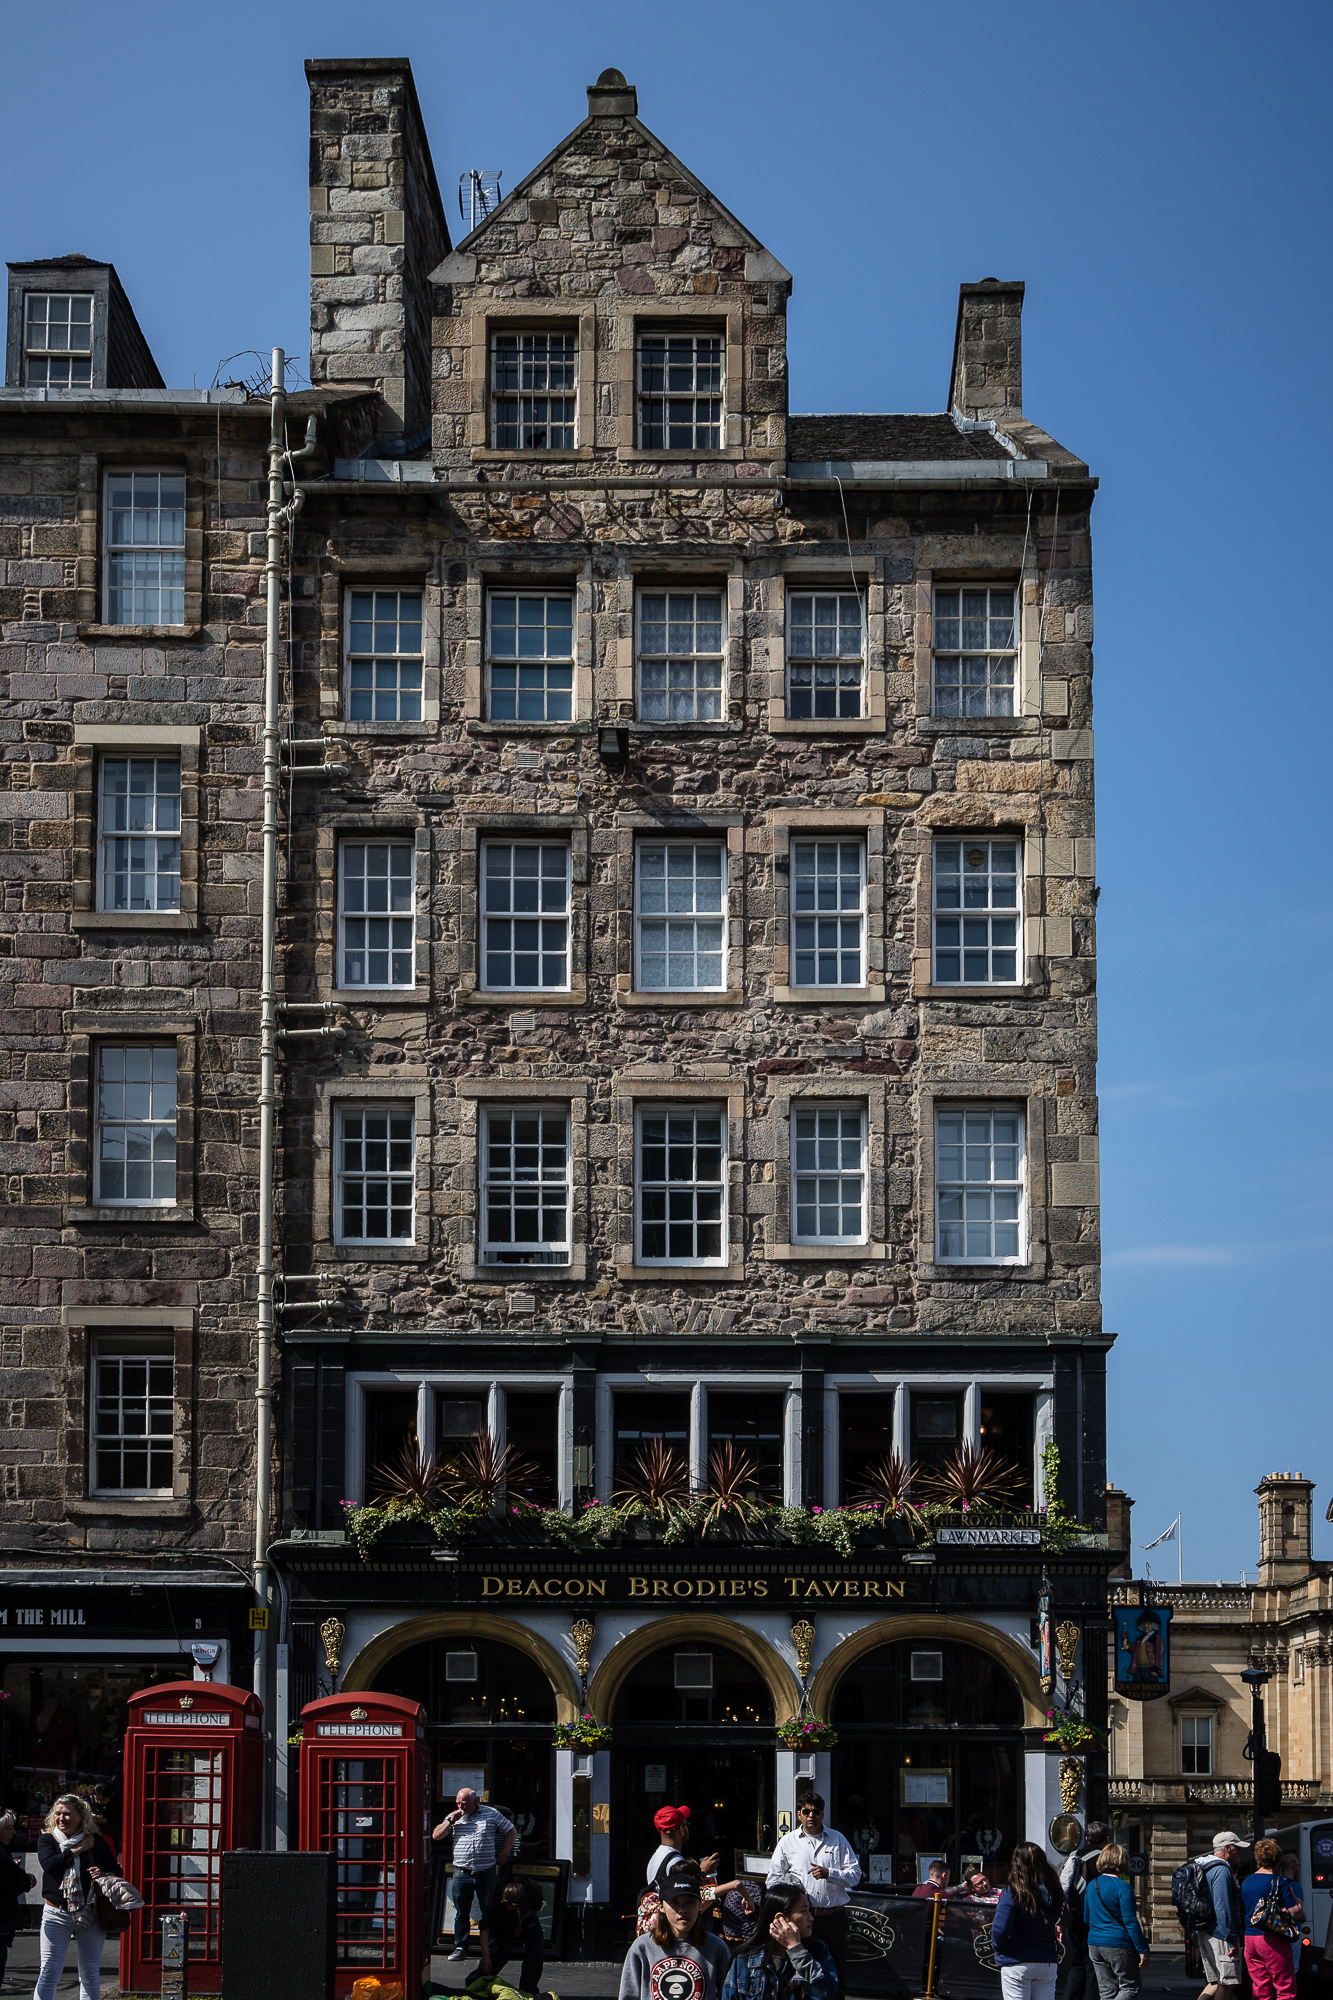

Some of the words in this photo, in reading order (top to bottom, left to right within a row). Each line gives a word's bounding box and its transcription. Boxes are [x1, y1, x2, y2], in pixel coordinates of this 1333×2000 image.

[933, 1514, 957, 1527] THE
[961, 1514, 1007, 1527] ROYAL
[1012, 1514, 1047, 1527] MILE
[939, 1530, 1039, 1543] LAWNMARKET
[481, 1576, 608, 1597] DEACON
[628, 1576, 769, 1598] BRODIE'S
[784, 1577, 906, 1598] TAVERN
[15, 1609, 44, 1625] THE
[50, 1609, 87, 1626] MILL
[1117, 1683, 1141, 1691] DEACON
[1127, 1691, 1159, 1699] TAVERN
[147, 1713, 226, 1725] TELEPHONE
[320, 1725, 399, 1736] TELEPHONE
[1130, 1860, 1144, 1869] 20
[652, 1959, 678, 1982] AAPE
[679, 1960, 702, 1981] NOW!
